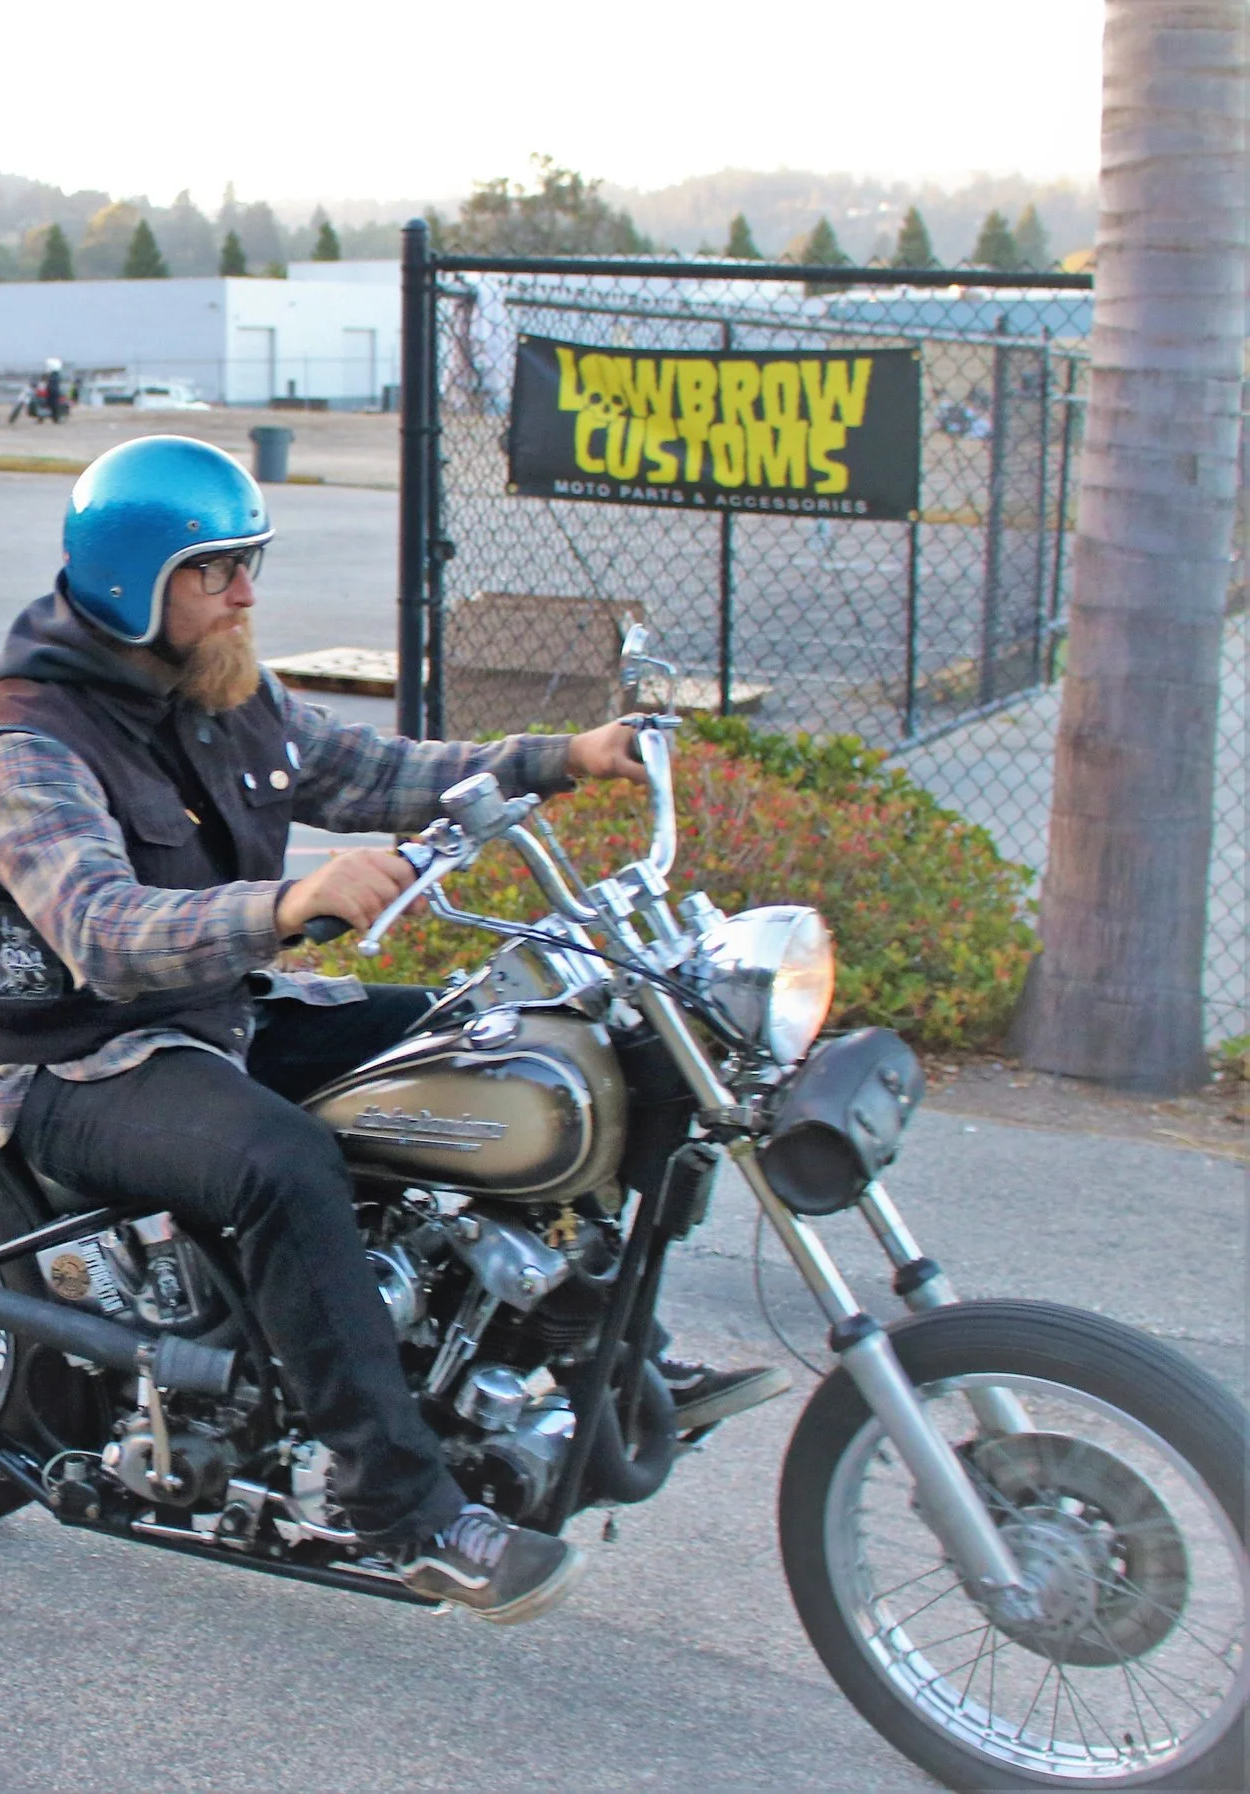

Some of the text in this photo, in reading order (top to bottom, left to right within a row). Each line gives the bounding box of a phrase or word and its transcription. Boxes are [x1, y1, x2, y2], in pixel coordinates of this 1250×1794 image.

[555, 346, 873, 427] LOWBROW
[574, 410, 849, 494] CUSTOMS
[554, 479, 868, 514] MOTO PARTS & ACCESSORIES
